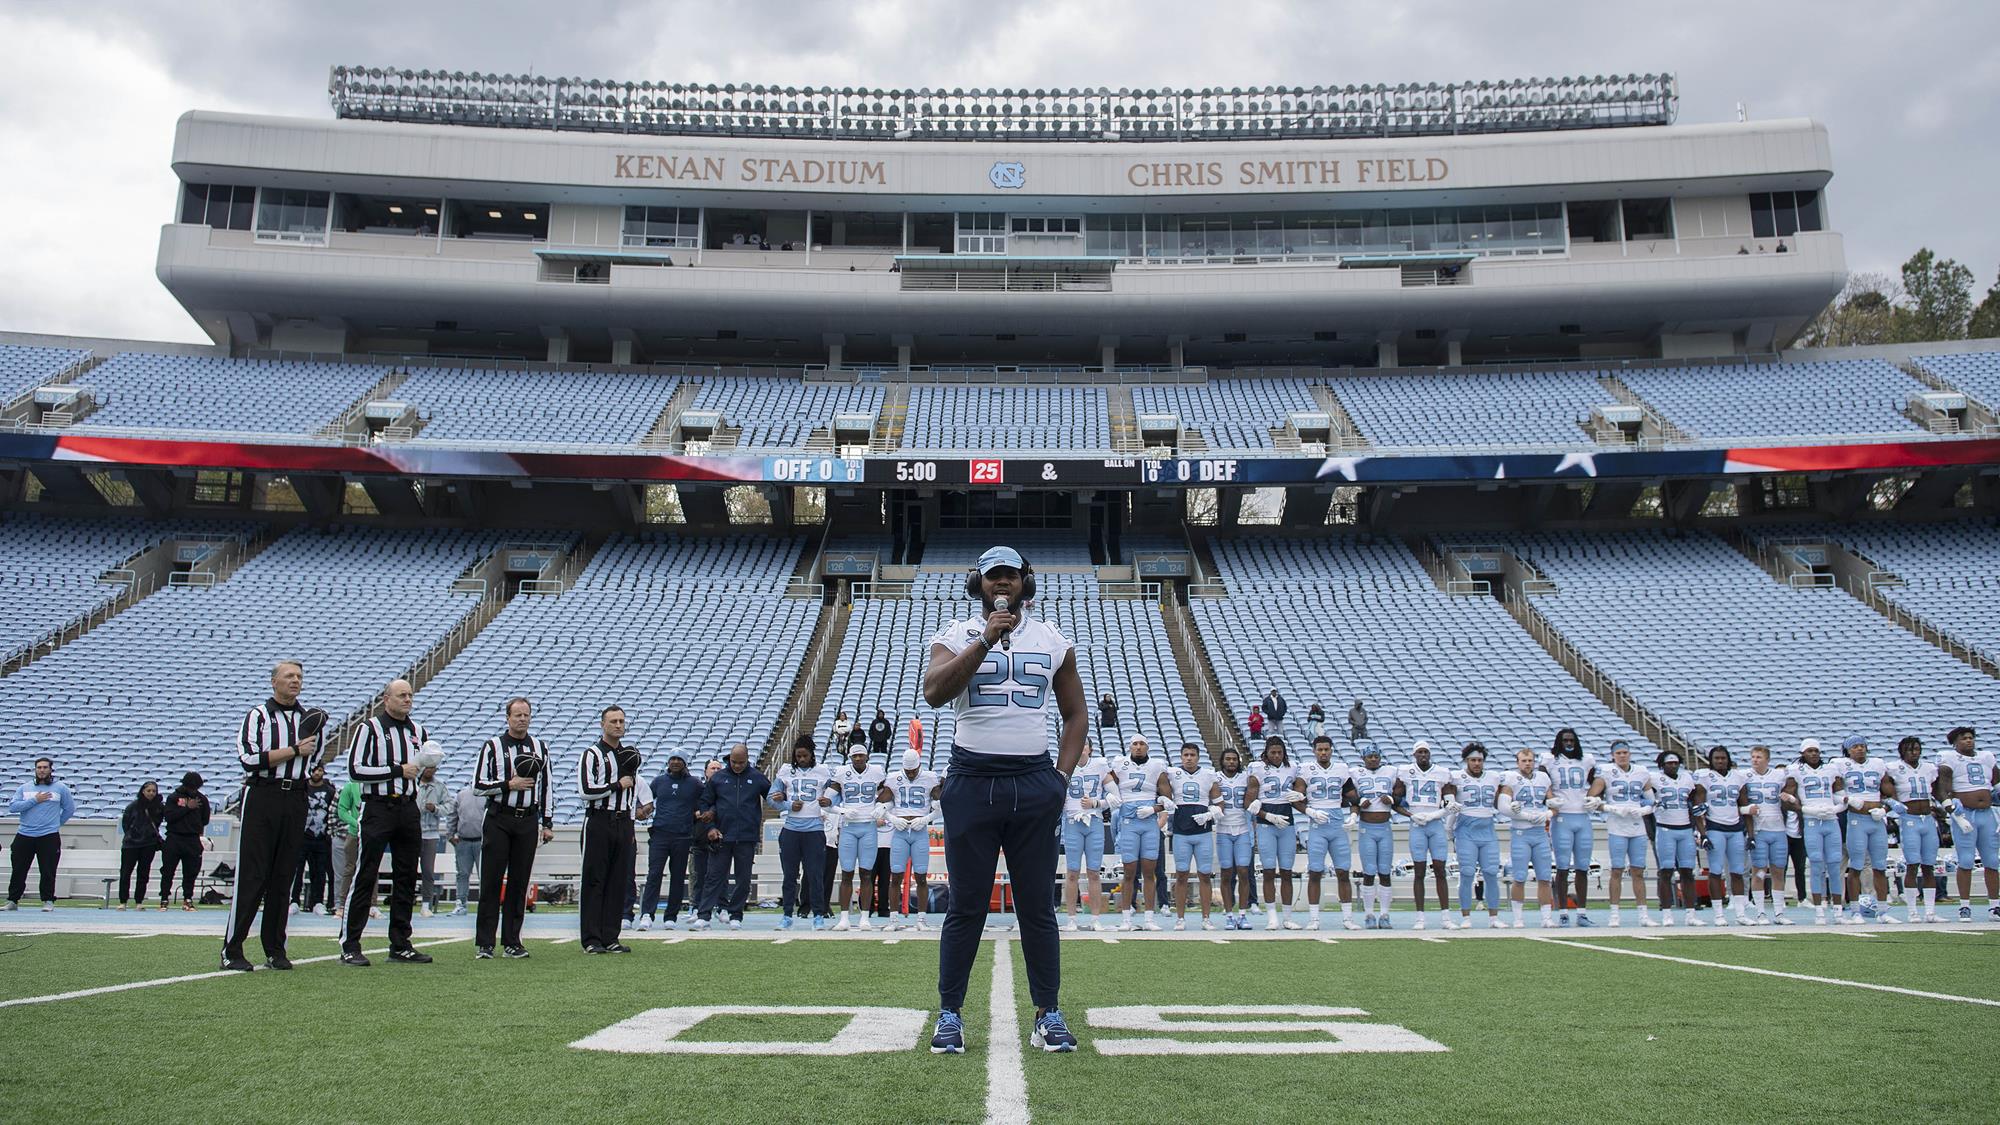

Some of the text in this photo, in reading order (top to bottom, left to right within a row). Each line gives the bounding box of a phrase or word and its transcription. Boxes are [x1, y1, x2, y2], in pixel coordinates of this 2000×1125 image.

[615, 155, 887, 185] KENAN STADIUM
[1127, 158, 1449, 187] CHRIS SMITH FIELD
[774, 459, 832, 480] OFF 0
[845, 460, 860, 468] TOL
[847, 469, 856, 480] 0
[897, 461, 936, 481] 5:00
[974, 463, 999, 480] 25
[1146, 461, 1162, 469] TOL
[1178, 461, 1236, 481] 0 DEF
[1149, 469, 1158, 482] 0
[968, 652, 1052, 710] 25
[1128, 773, 1146, 792] 7
[1558, 767, 1585, 789] 10
[1845, 771, 1880, 793] 33
[1967, 763, 1985, 785] 8
[791, 779, 819, 803] 15
[843, 782, 876, 803] 29
[898, 786, 926, 808] 16
[1068, 774, 1100, 799] 87
[1182, 782, 1200, 803] 9
[1310, 777, 1342, 799] 32
[1357, 777, 1392, 799] 23
[1411, 779, 1438, 805] 14
[1516, 785, 1546, 808] 45
[1803, 776, 1831, 799] 21
[1908, 776, 1929, 798] 11
